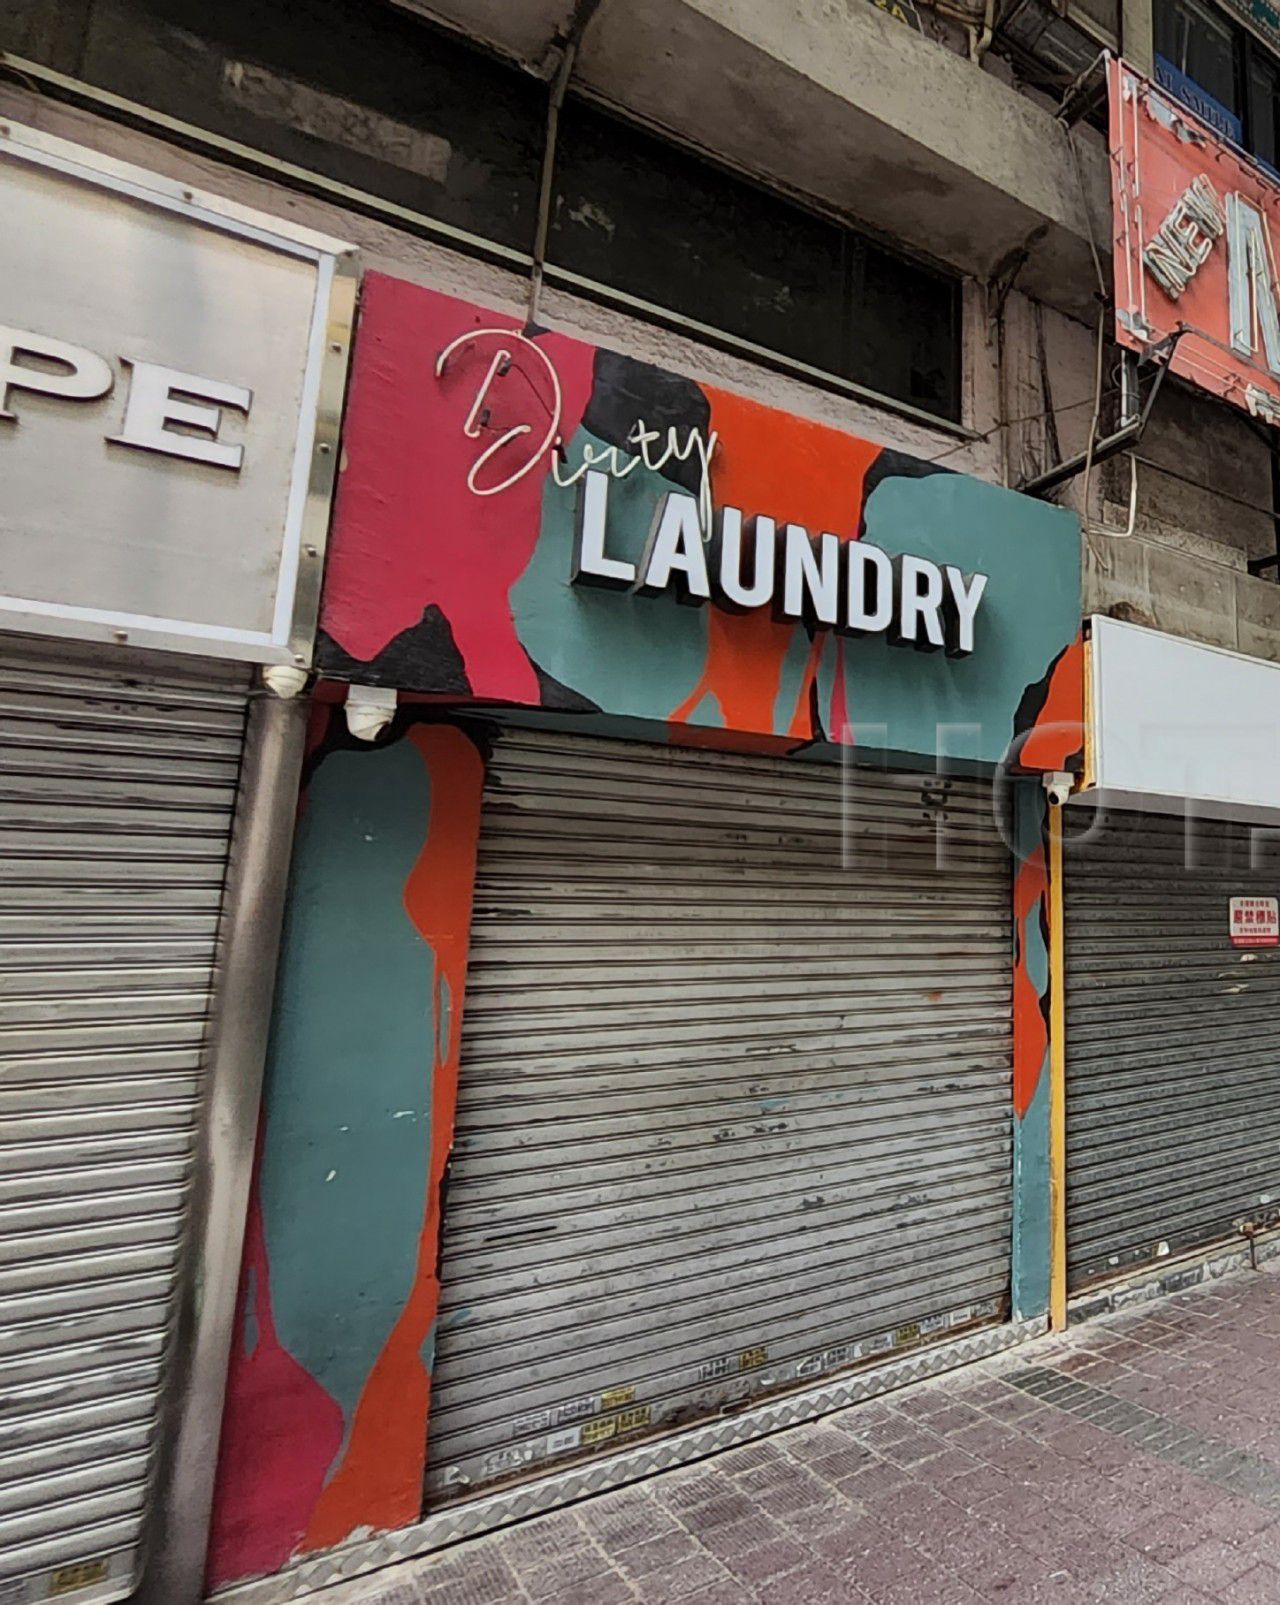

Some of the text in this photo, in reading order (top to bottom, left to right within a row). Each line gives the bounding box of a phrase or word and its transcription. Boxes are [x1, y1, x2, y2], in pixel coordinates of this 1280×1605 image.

[1143, 173, 1227, 299] NEW
[435, 327, 718, 543] Dirty
[577, 470, 990, 654] LAUNDRY
